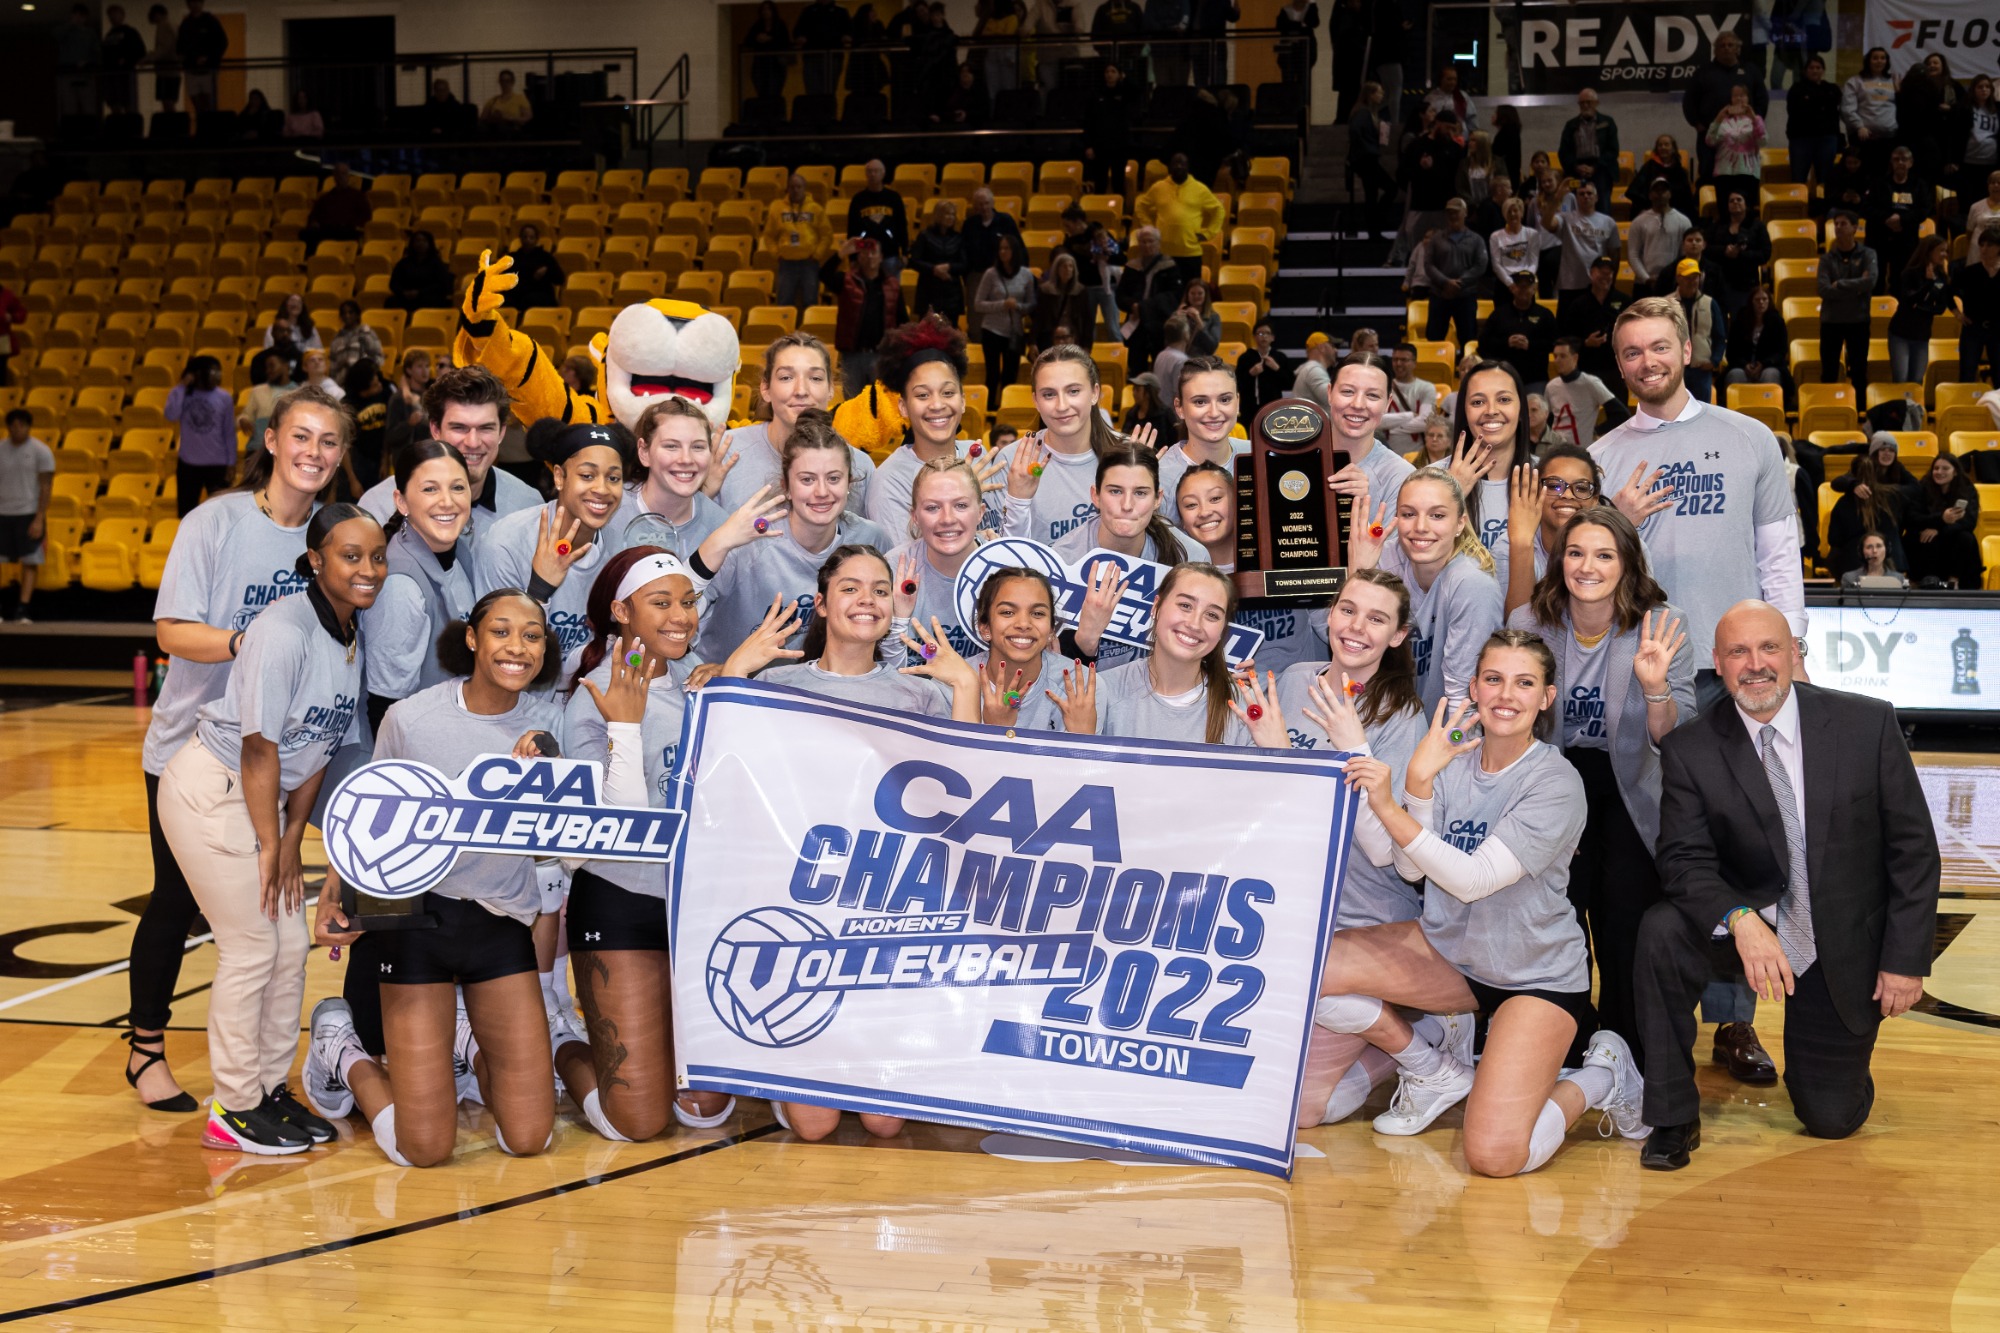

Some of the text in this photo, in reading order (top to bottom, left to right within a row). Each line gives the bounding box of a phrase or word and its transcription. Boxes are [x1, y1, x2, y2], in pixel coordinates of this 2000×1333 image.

[1521, 13, 1742, 68] READY
[1600, 65, 1699, 82] SPORTS DR
[1272, 416, 1312, 429] CAA
[1554, 403, 1579, 446] A
[1675, 492, 1726, 516] 2022
[1289, 512, 1304, 520] 2022
[1282, 524, 1313, 533] WOMEN'S
[1278, 537, 1319, 546] VOLLEYBALL
[1280, 550, 1318, 559] CHAMPIONS
[1275, 577, 1338, 587] TOWSON UNIVERSITY
[1841, 676, 1891, 688] DRINK
[334, 694, 355, 713] CAA
[467, 757, 597, 806] CAA
[873, 759, 1122, 864] CAA
[346, 797, 670, 871] VOLLEYBALL
[1449, 819, 1488, 838] CAA
[788, 822, 1276, 959] CHAMPIONS
[846, 914, 961, 935] WOMEN'S
[729, 942, 1089, 1022] VOLLEYBALL
[1041, 945, 1267, 1048] 2022
[1040, 1029, 1190, 1076] TOWSON
